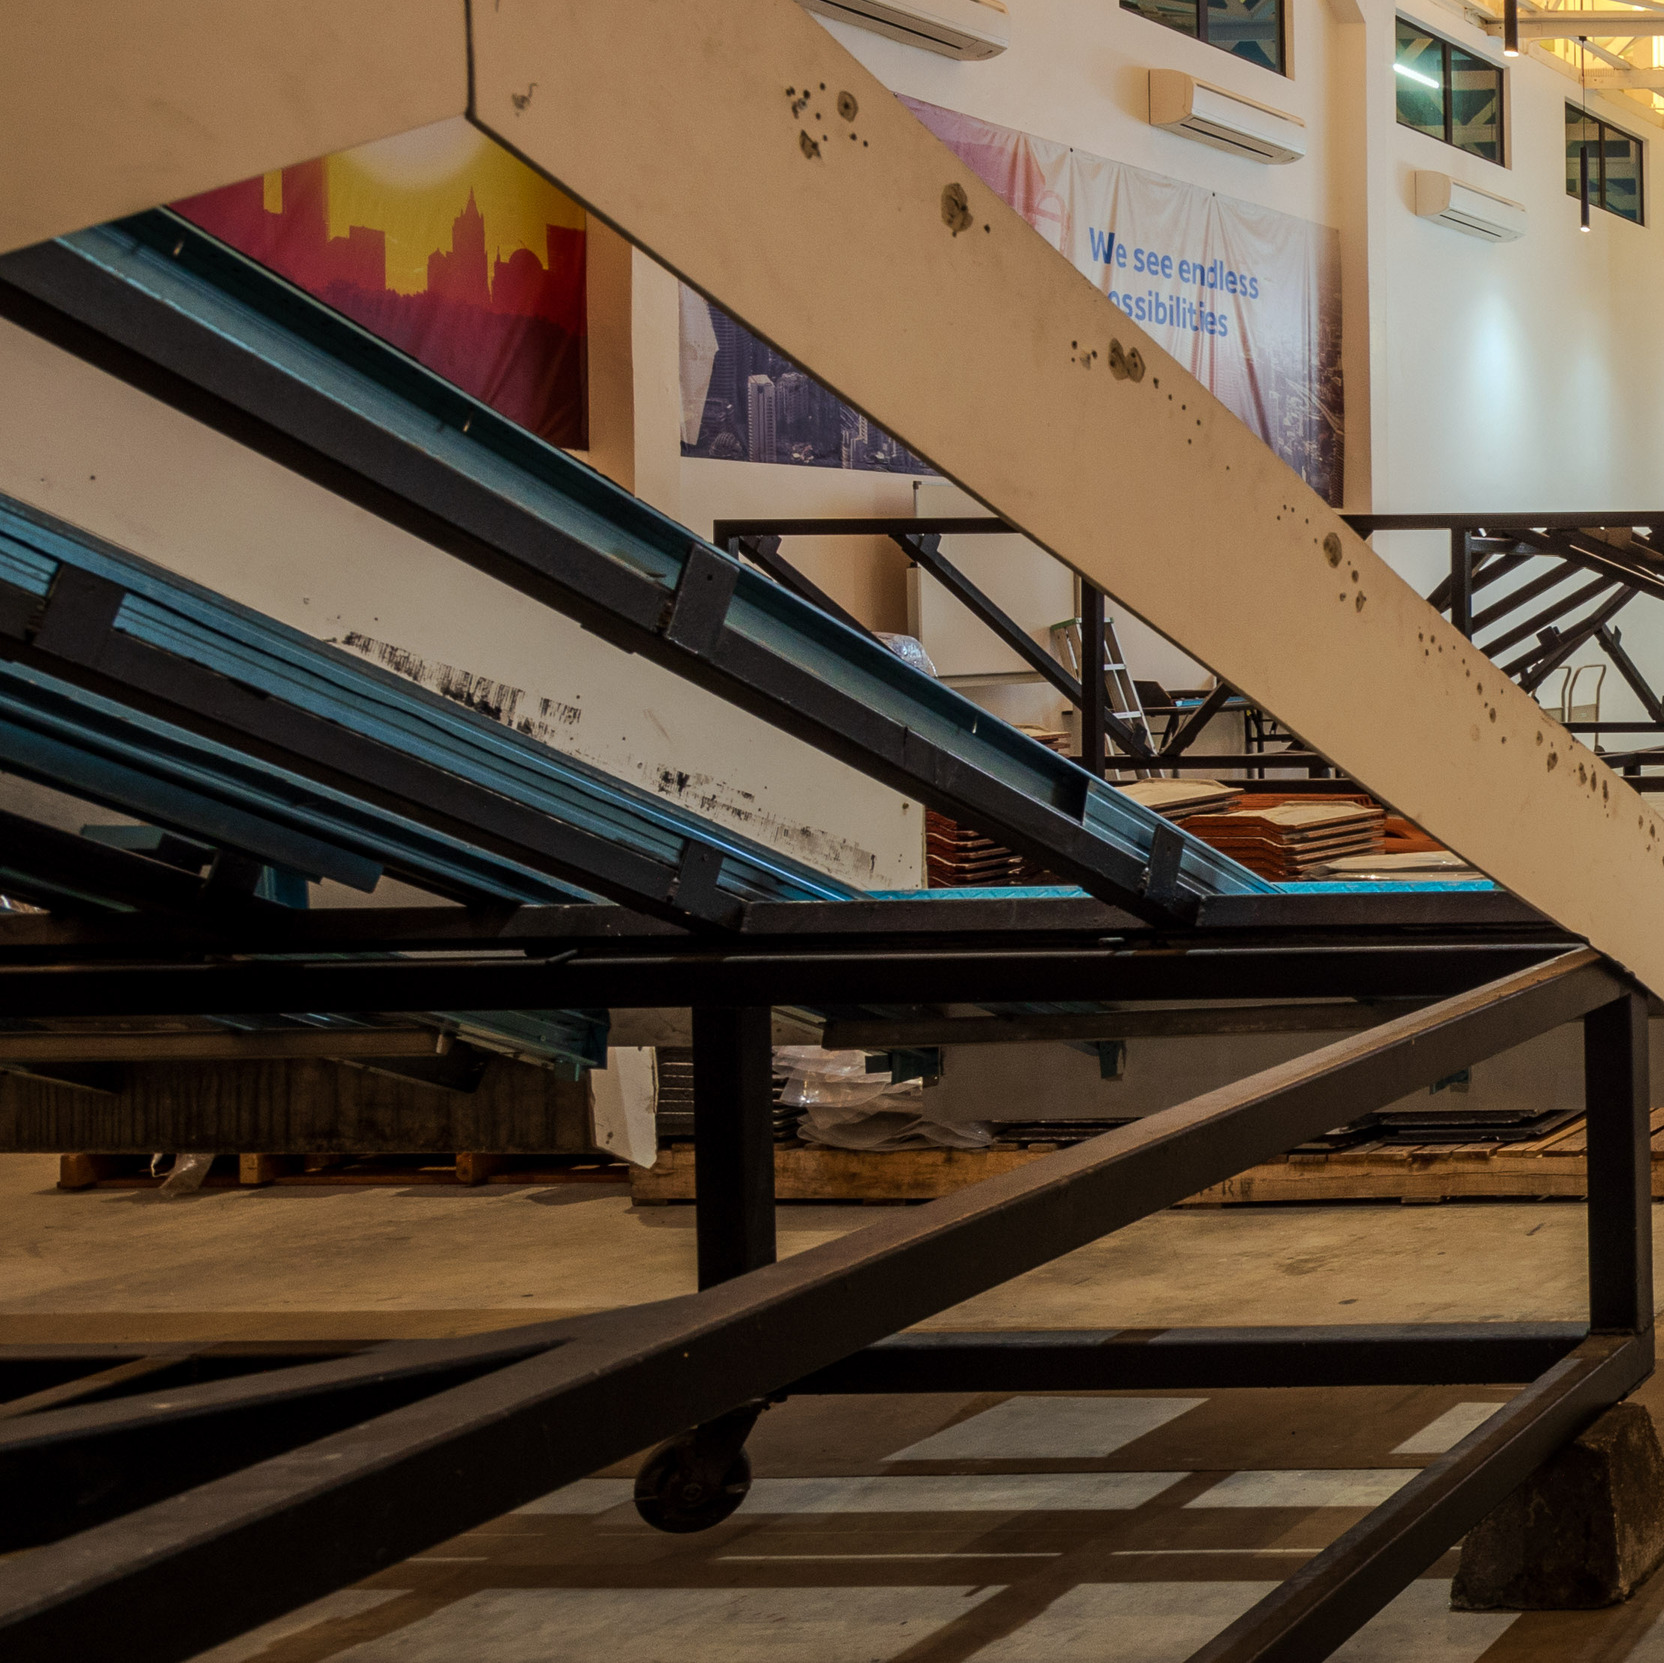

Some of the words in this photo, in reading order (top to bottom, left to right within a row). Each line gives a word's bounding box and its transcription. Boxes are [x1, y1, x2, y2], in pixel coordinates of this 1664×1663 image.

[1088, 226, 1127, 268] We
[1133, 247, 1174, 279] see
[1178, 258, 1259, 300] endless
[1107, 289, 1229, 338] ossibilities
